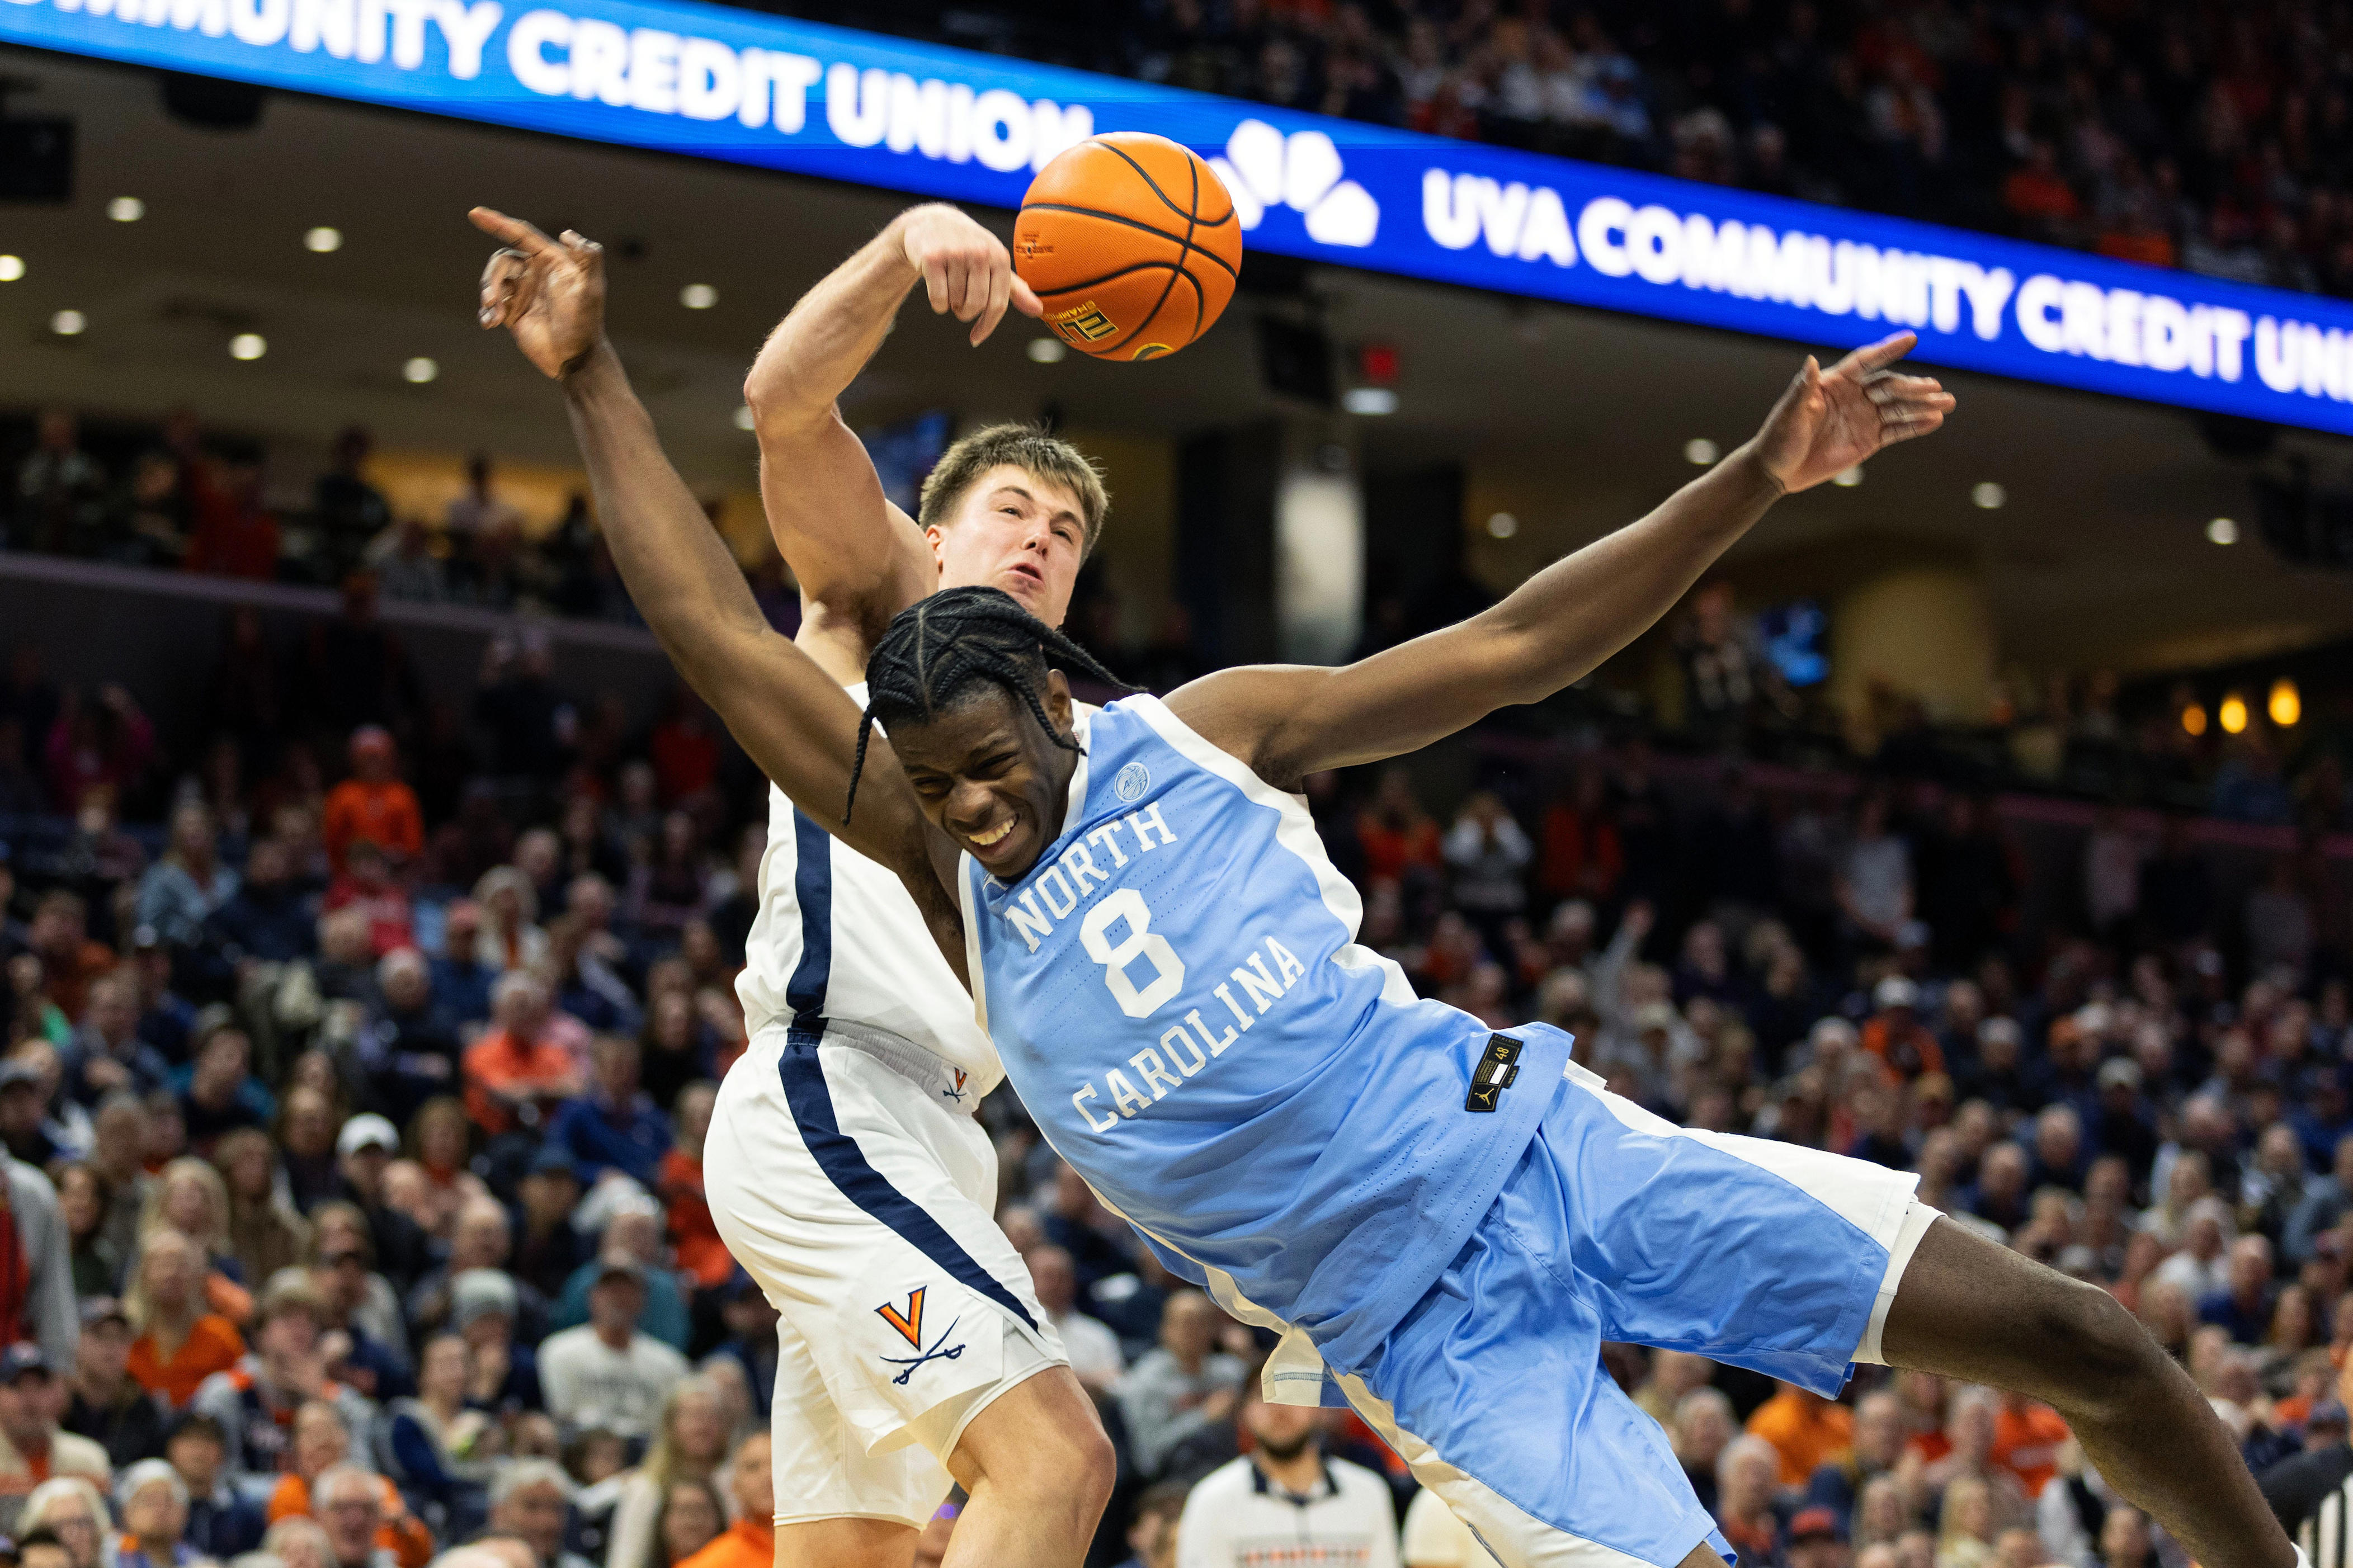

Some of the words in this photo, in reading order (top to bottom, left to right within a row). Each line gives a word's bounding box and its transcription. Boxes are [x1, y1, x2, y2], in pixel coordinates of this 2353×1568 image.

[507, 10, 823, 134] CREDIT
[827, 62, 1093, 174] UNION
[1422, 167, 1578, 268] UVA
[1578, 196, 2016, 340] COMMUNITY
[2016, 273, 2252, 382] CREDIT
[1005, 801, 1178, 954] NORTH
[1079, 887, 1186, 1019] 8
[1072, 936, 1306, 1134] CAROLINA
[1495, 1047, 1510, 1060] 48
[874, 1284, 927, 1352] V
